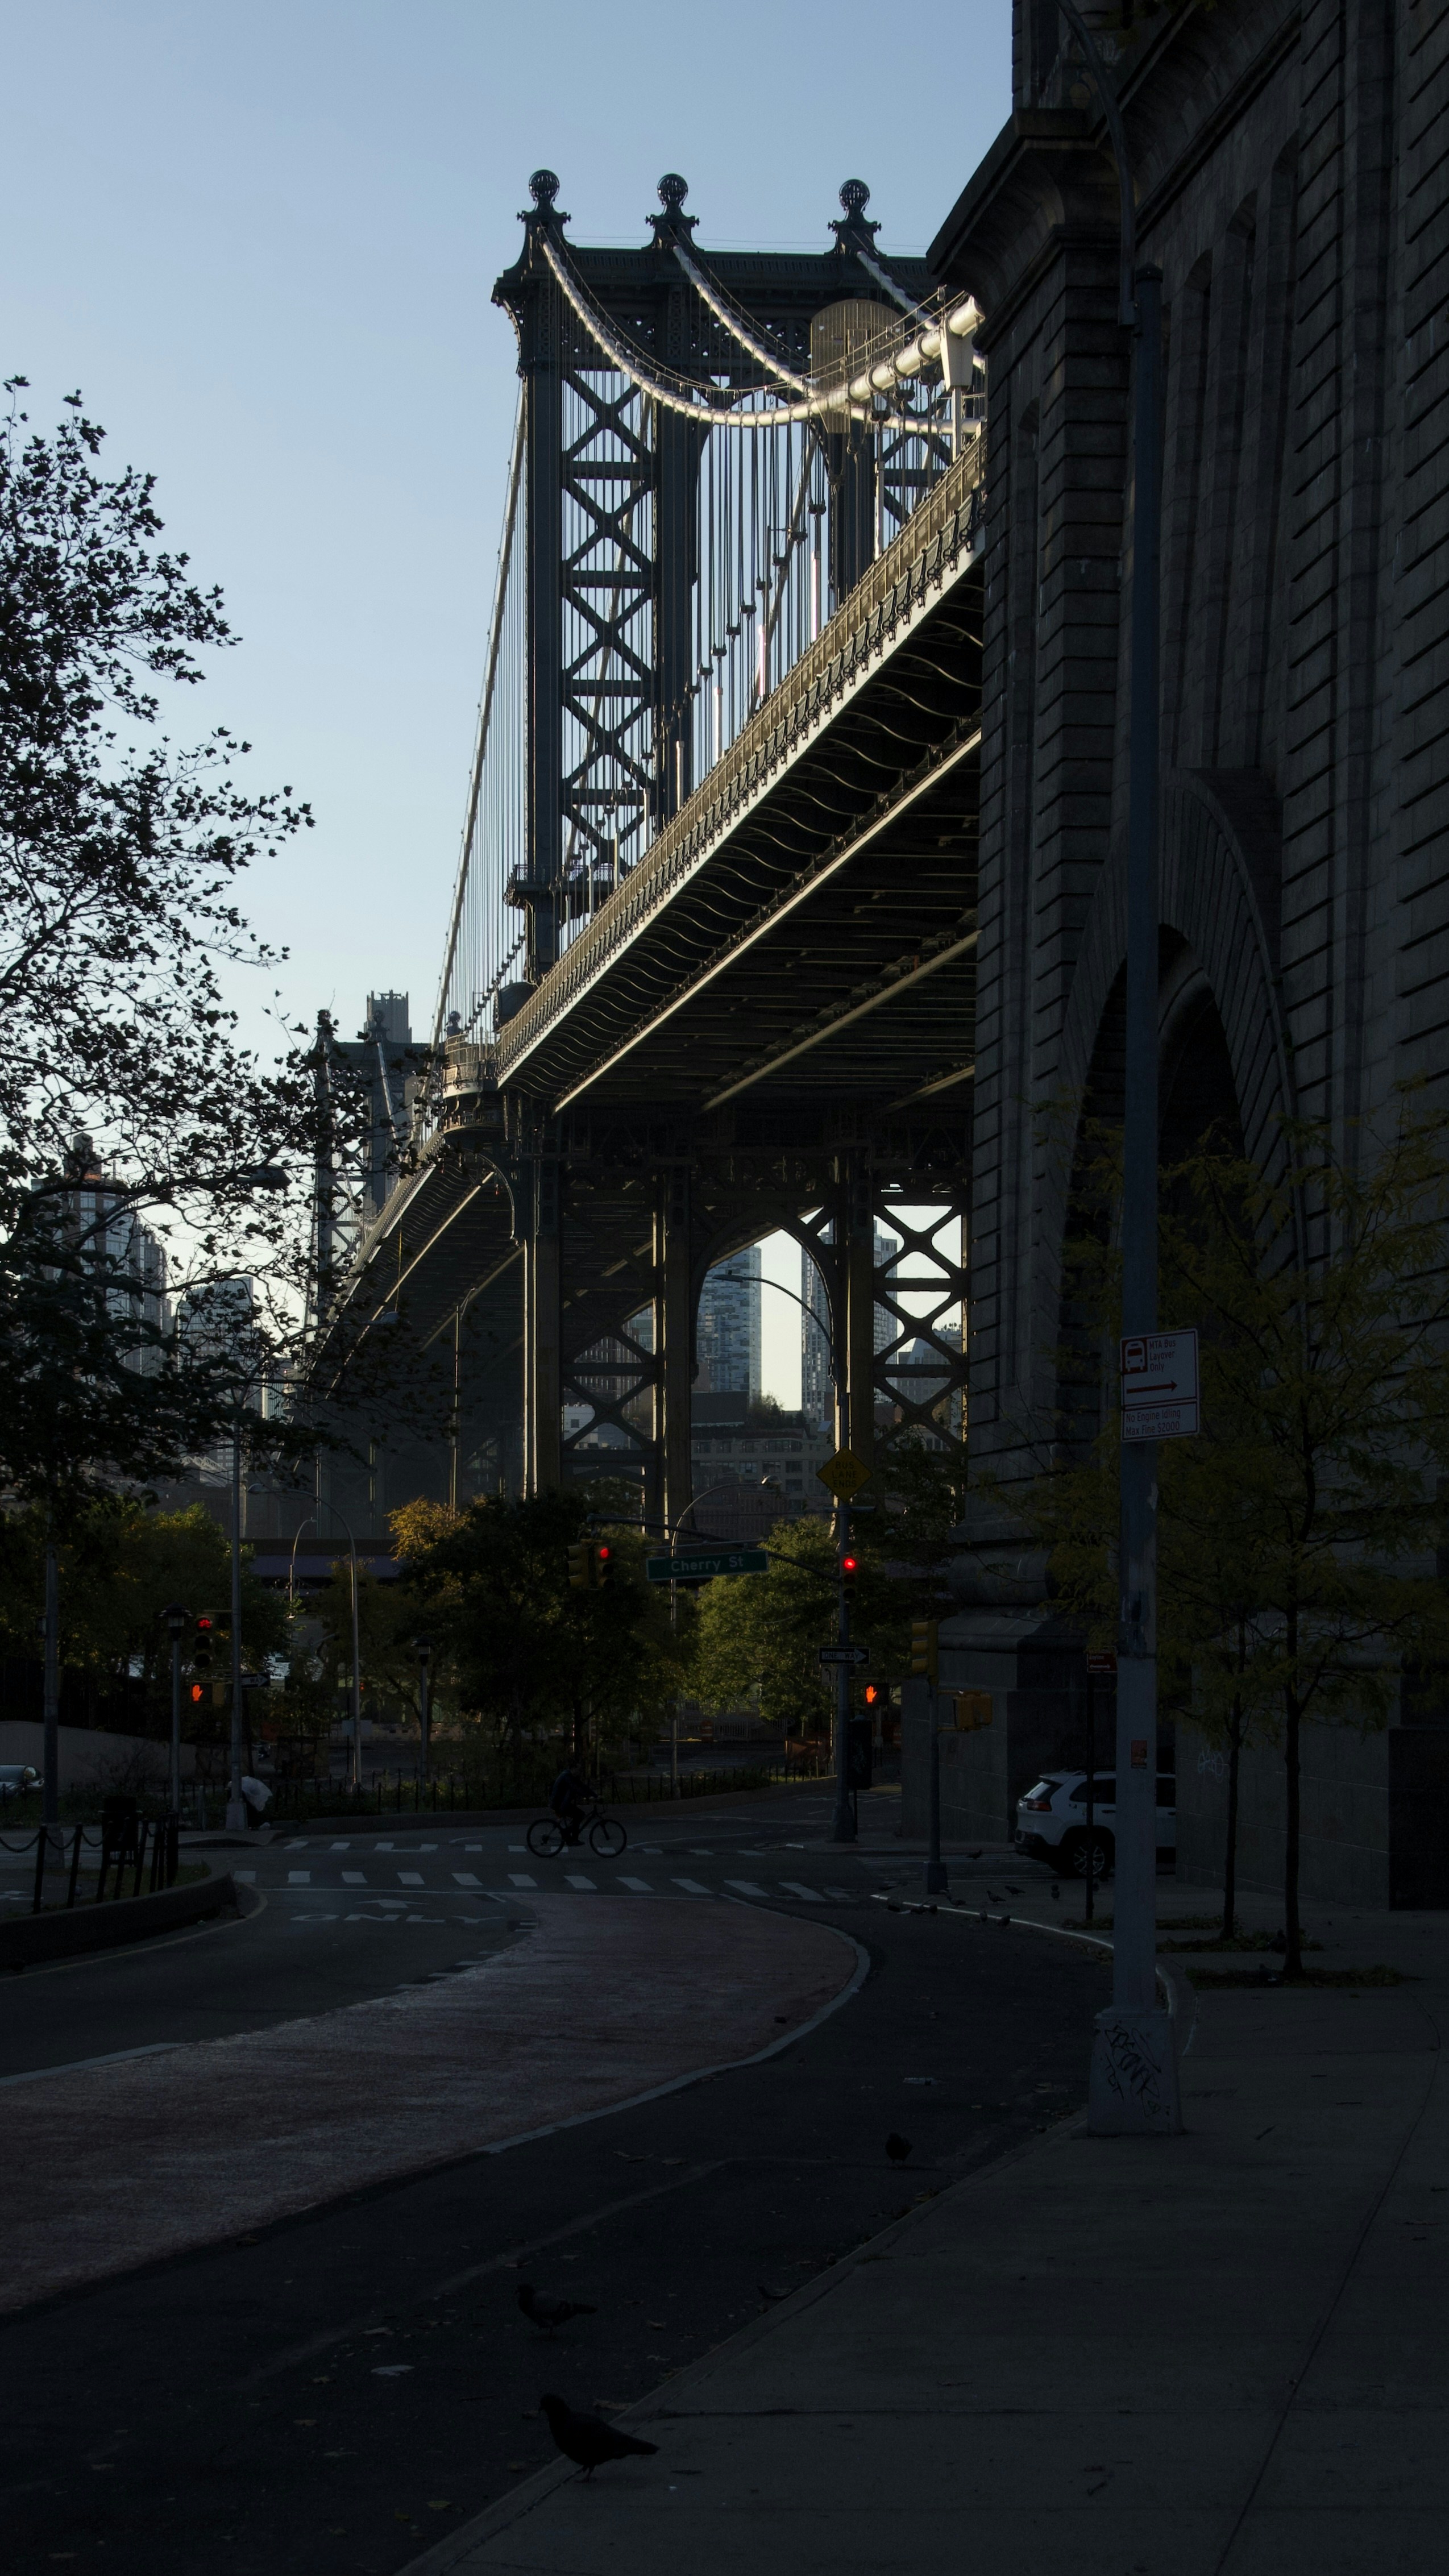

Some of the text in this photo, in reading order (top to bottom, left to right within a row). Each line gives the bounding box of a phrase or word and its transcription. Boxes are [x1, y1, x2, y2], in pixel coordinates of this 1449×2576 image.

[1149, 1339, 1176, 1349] MTA Bus
[1149, 1351, 1175, 1361] Layover
[1150, 1362, 1164, 1372] Only
[1126, 1409, 1181, 1422] No Engine Idling
[1126, 1421, 1180, 1436] Max Fine $2000
[832, 1470, 857, 1478] LANE
[671, 1555, 744, 1572] Cherry St
[289, 1913, 505, 1923] ONLY
